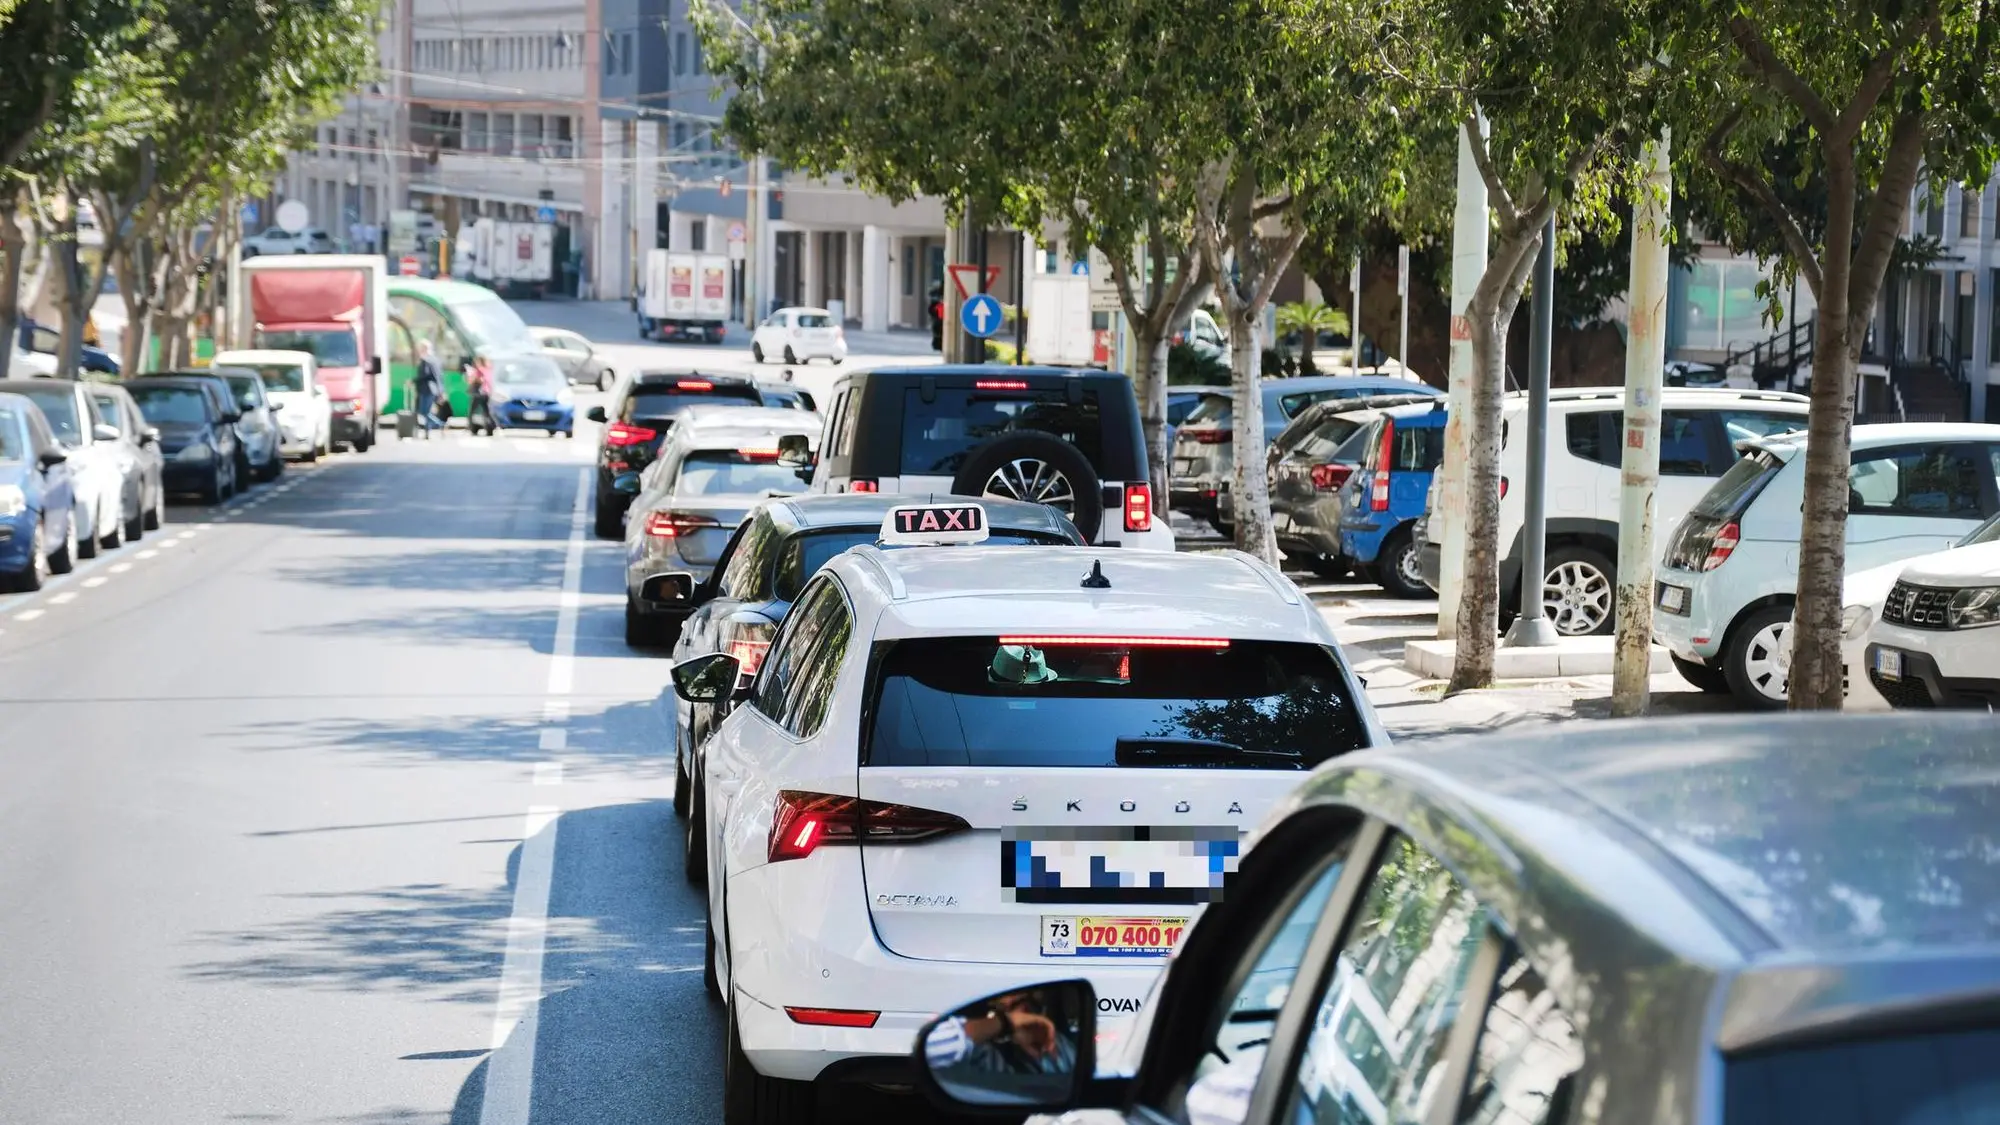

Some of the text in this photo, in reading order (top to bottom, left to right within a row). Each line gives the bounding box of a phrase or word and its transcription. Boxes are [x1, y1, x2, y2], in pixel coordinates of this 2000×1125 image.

[898, 509, 976, 532] TAXI
[877, 893, 958, 907] OCTAVIA
[1050, 924, 1070, 938] 73
[1080, 926, 1118, 946] 070
[1122, 926, 1161, 946] 400
